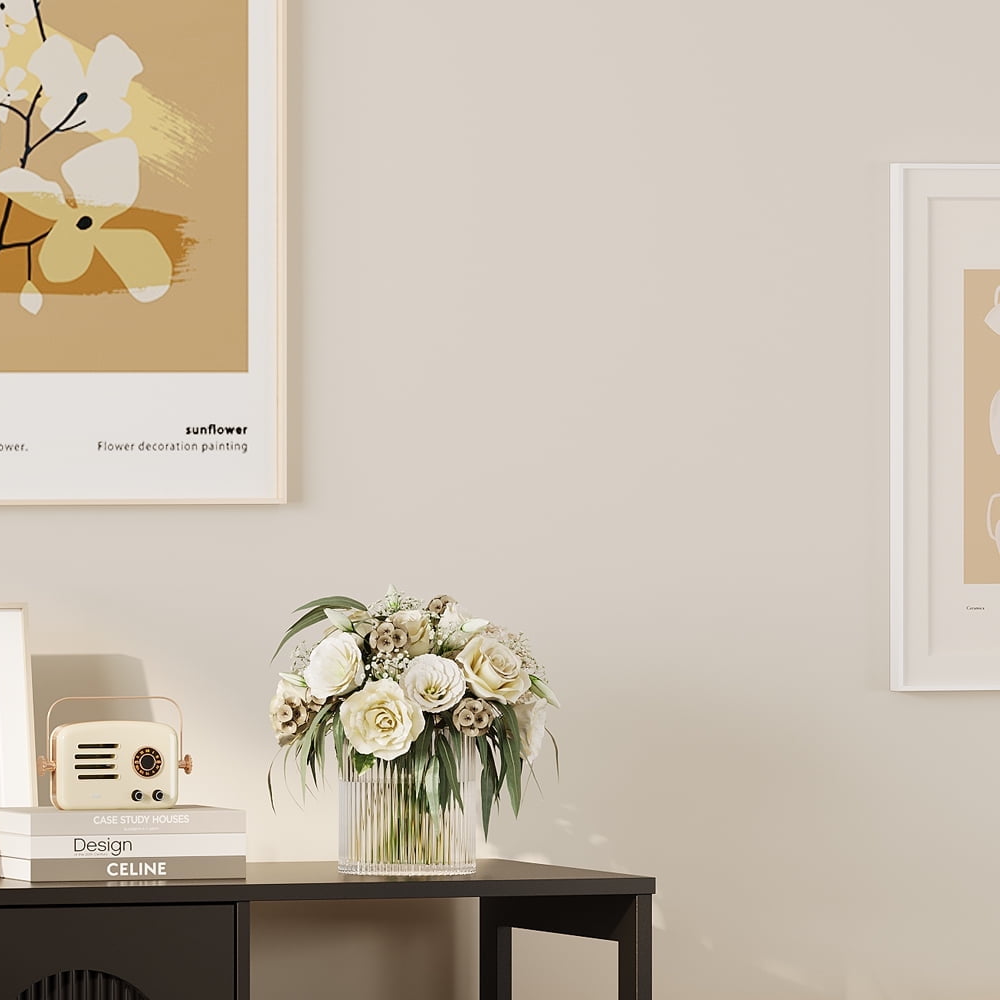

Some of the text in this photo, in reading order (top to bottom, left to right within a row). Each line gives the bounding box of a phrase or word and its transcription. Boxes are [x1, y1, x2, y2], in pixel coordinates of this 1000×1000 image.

[185, 424, 248, 435] sunflower
[97, 441, 248, 454] Flower decoration painting
[93, 814, 190, 825] CASE STUDY HOUSES
[73, 837, 133, 856] Design
[106, 862, 167, 877] CELINE
